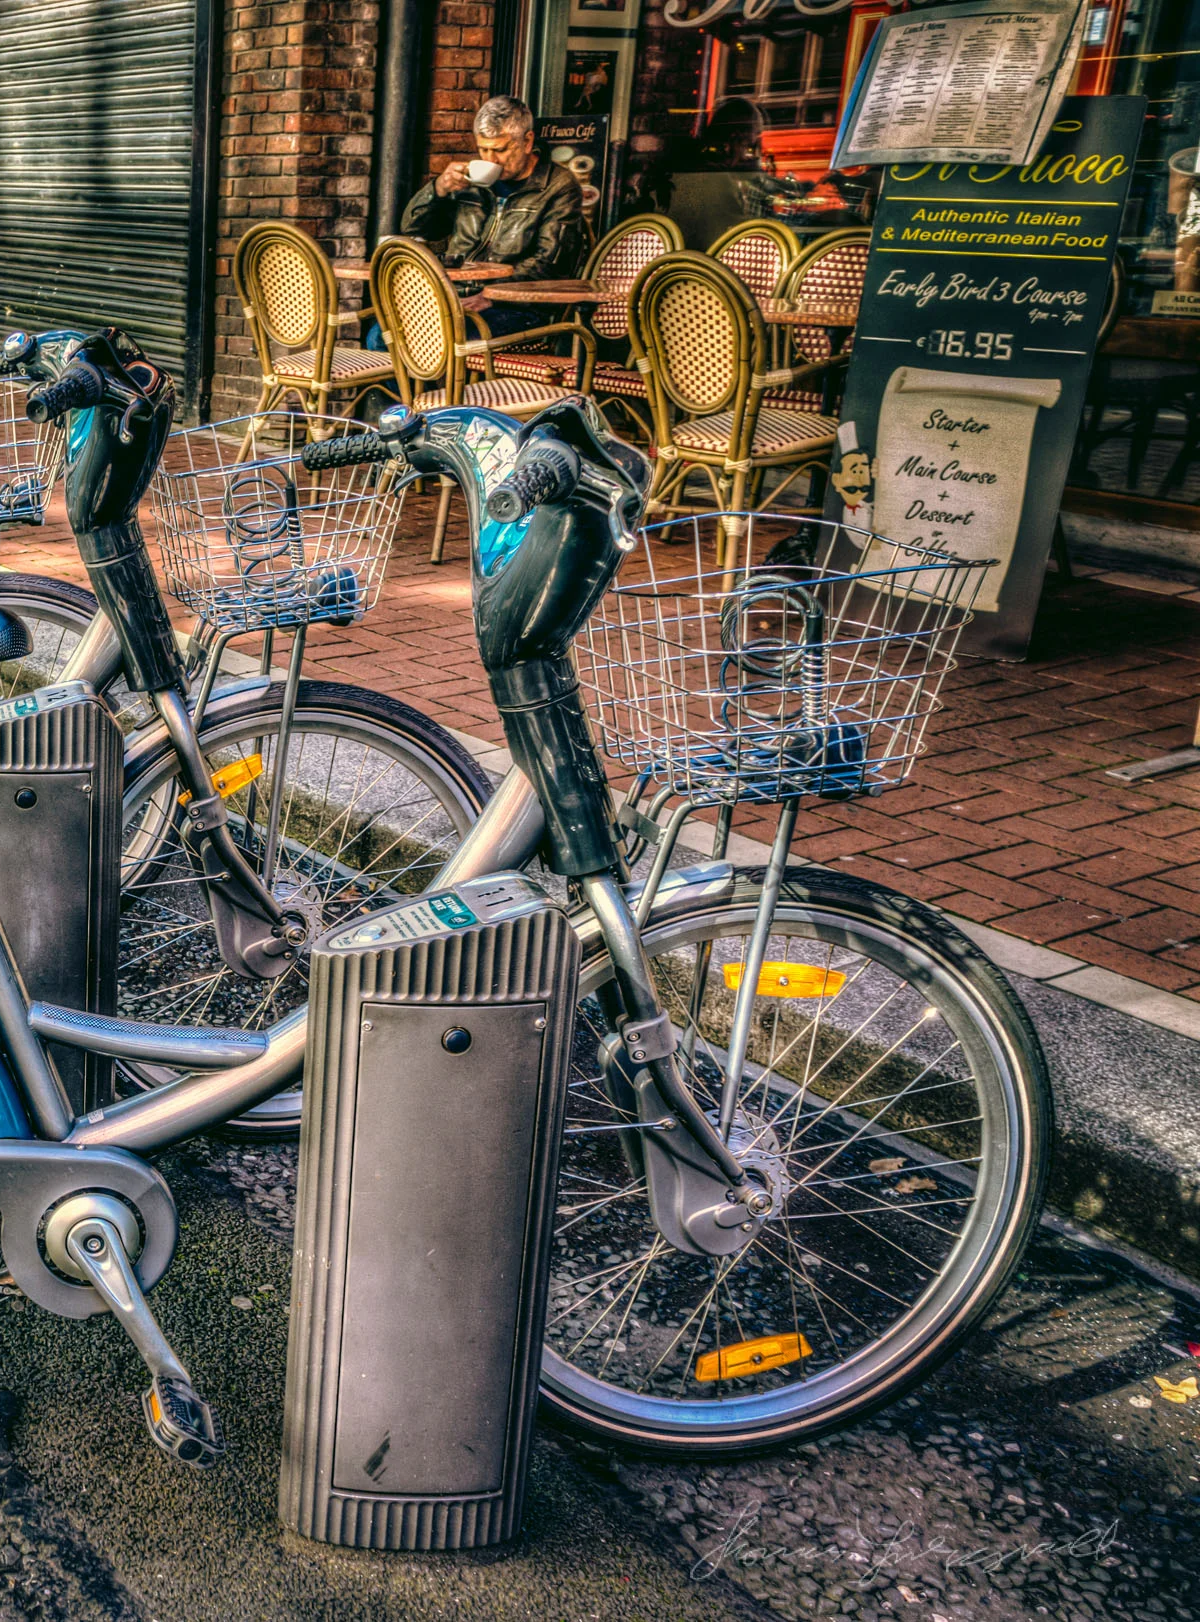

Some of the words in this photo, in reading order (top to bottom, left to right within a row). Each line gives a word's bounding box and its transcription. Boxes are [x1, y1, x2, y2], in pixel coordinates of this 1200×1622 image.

[911, 208, 1009, 224] Authentic
[1015, 211, 1082, 227] Italian
[881, 227, 895, 240] &
[901, 228, 1049, 245] Mediterranean
[1050, 233, 1108, 248] Food
[877, 269, 938, 308] Early
[940, 273, 999, 300] Bird
[993, 281, 1011, 302] 3
[1012, 276, 1088, 306] Course
[923, 409, 991, 434] Starter
[895, 455, 938, 479] Main
[939, 460, 997, 485] Course
[905, 500, 975, 525] Dessert
